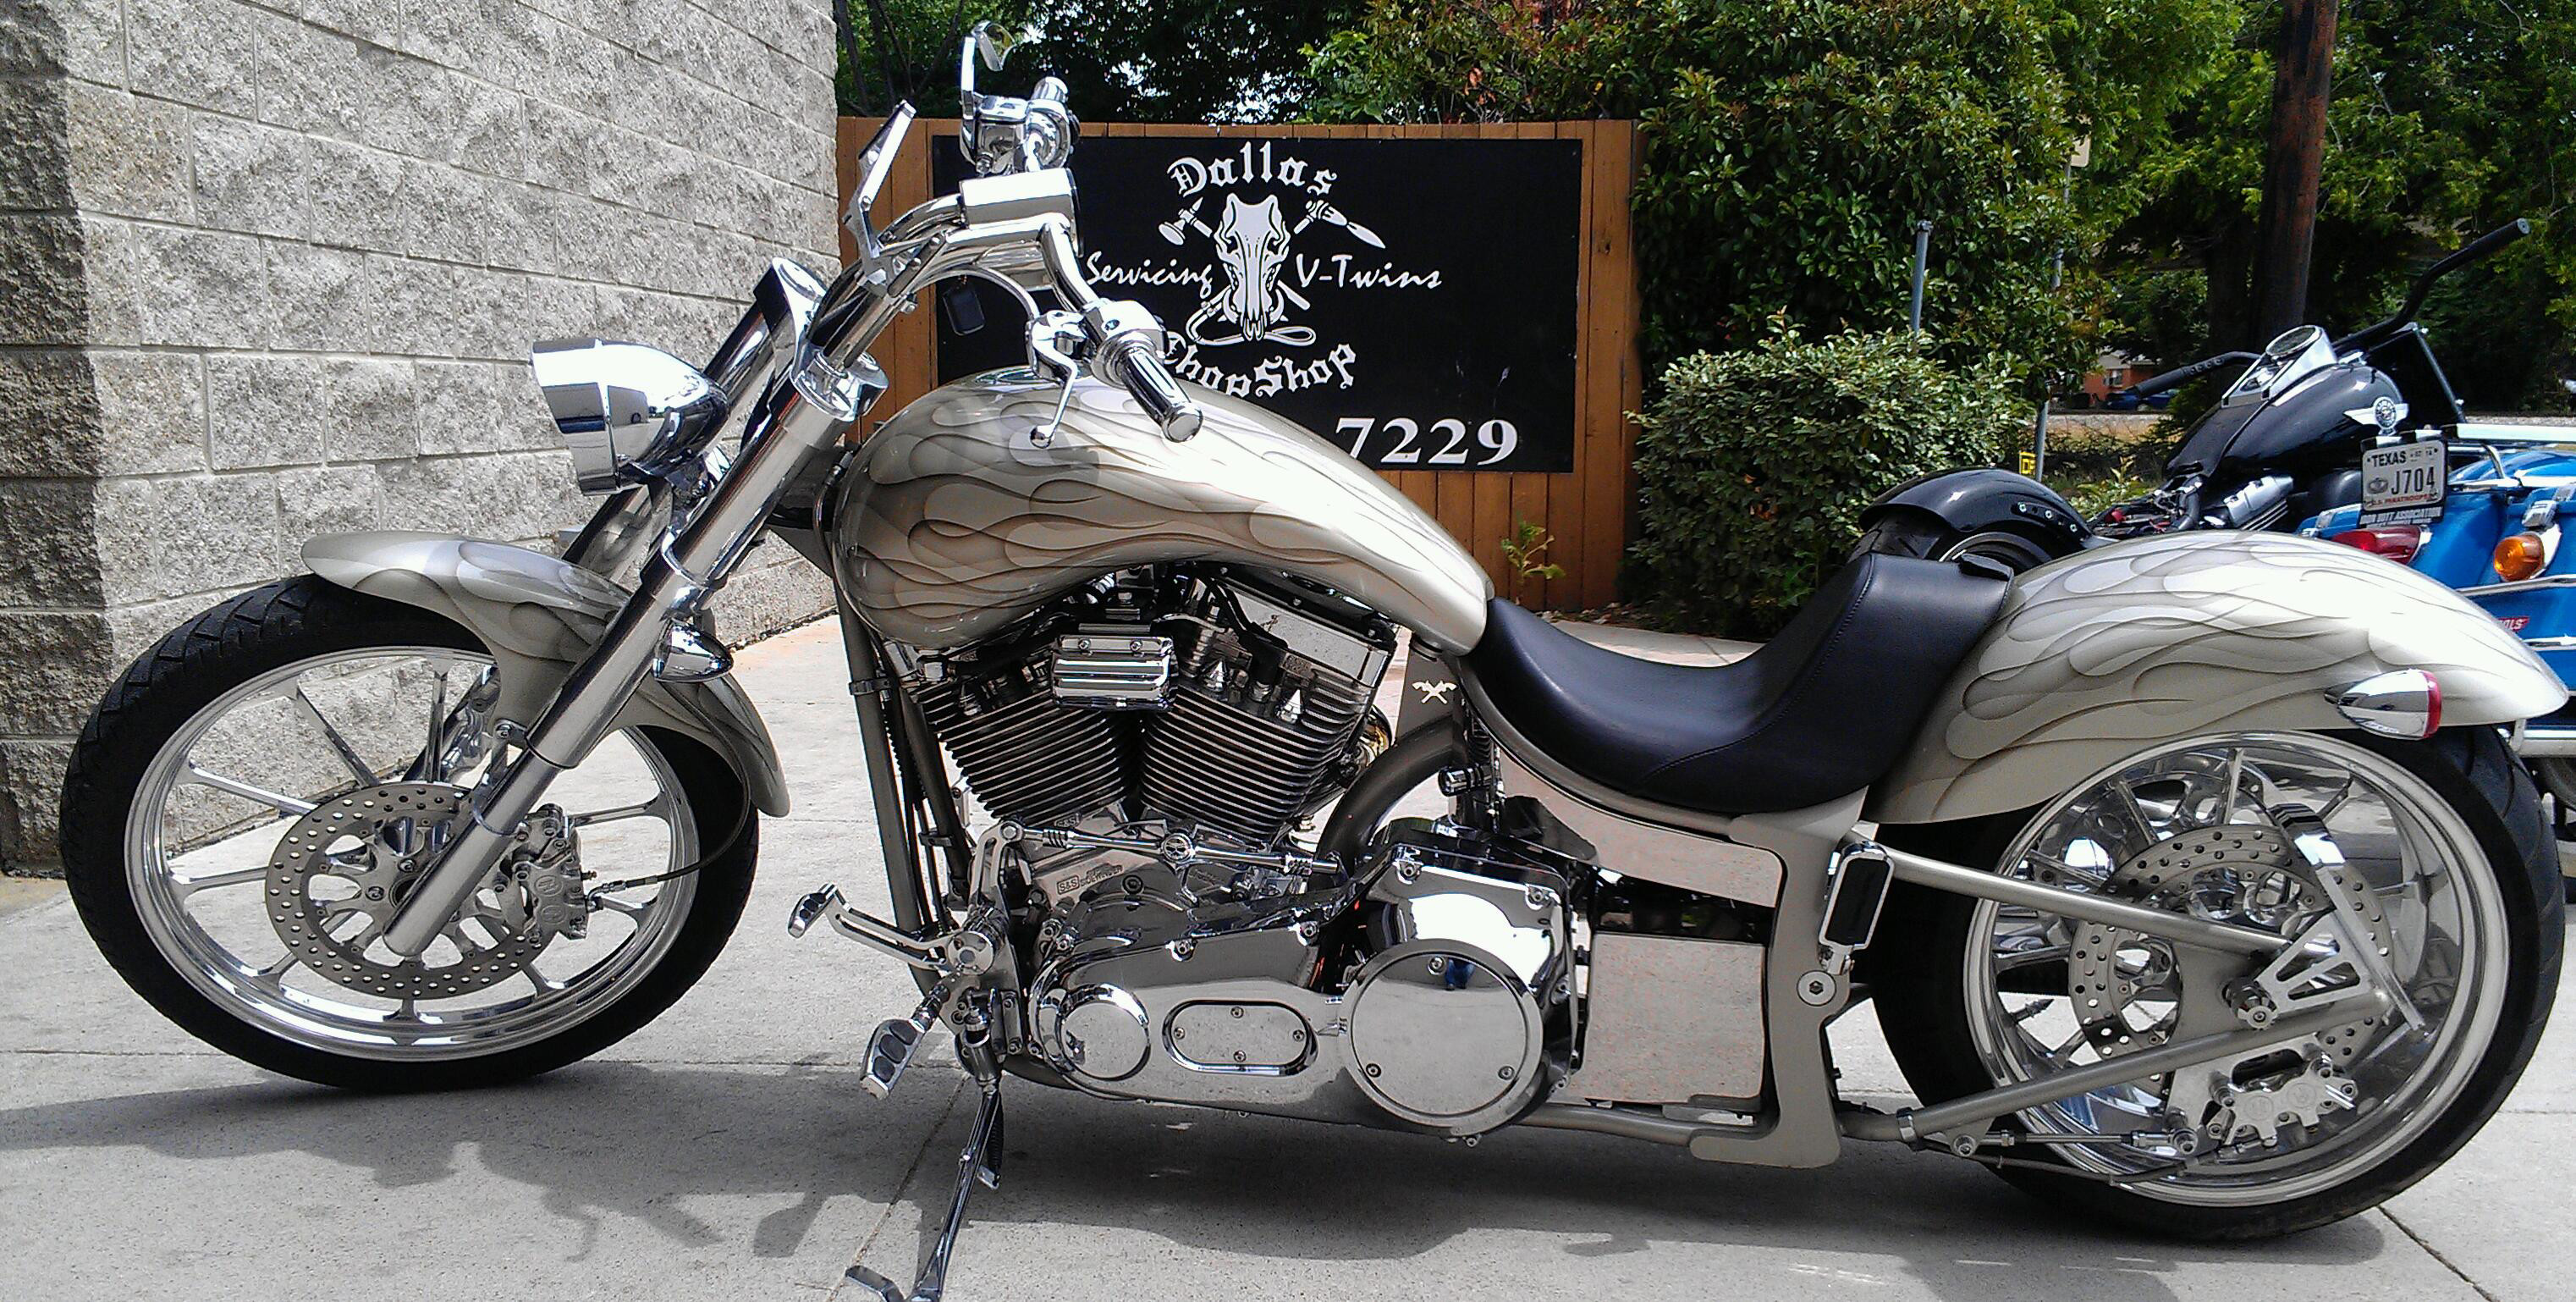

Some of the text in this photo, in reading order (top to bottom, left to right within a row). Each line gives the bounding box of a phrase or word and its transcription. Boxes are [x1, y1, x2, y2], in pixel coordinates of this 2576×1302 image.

[1167, 141, 1338, 197] Dallas
[1087, 251, 1442, 299] Servicing V-Twins
[1335, 417, 1517, 466] 7229
[2371, 450, 2407, 467] TEXAS
[2391, 466, 2435, 495] J704
[1059, 878, 1077, 892] S&S
